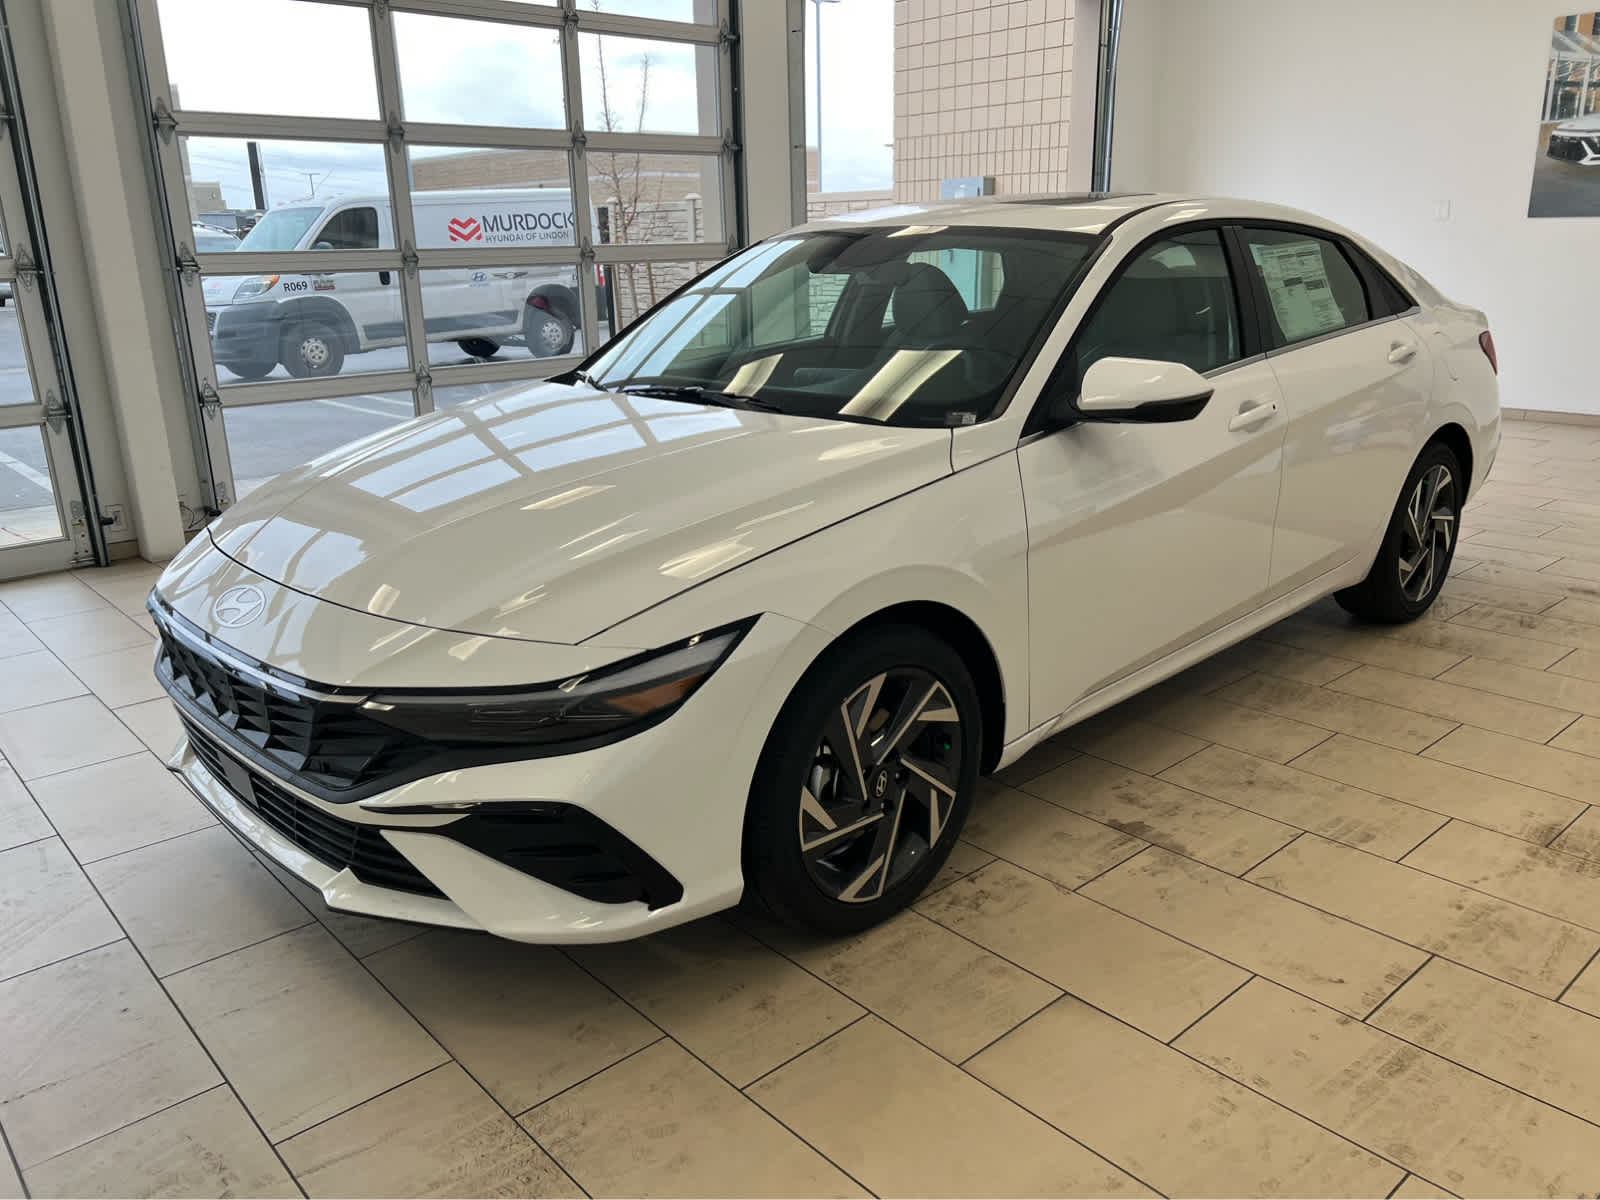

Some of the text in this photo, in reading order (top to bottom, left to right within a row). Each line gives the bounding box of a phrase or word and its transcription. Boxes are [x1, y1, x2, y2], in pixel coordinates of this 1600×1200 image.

[482, 212, 574, 233] MURDOCK
[485, 230, 569, 243] HYUNDAI OF LINDON
[283, 281, 307, 292] R069
